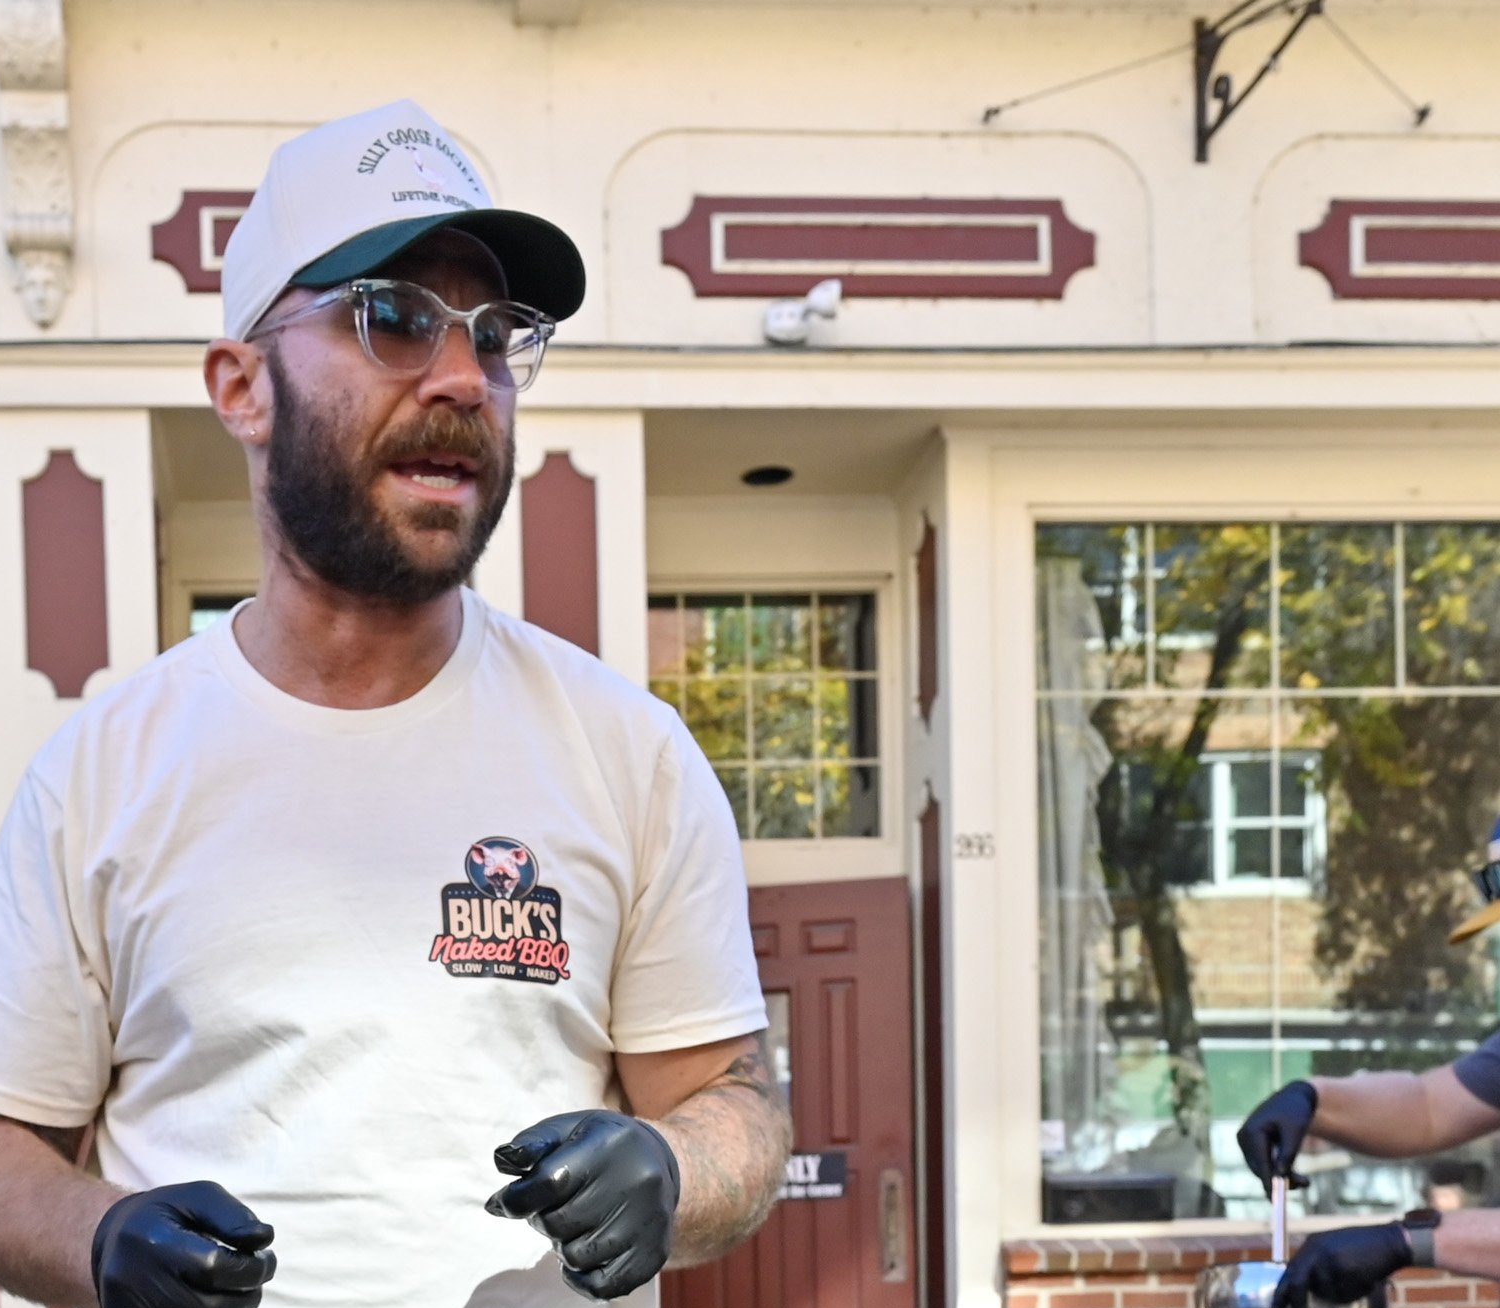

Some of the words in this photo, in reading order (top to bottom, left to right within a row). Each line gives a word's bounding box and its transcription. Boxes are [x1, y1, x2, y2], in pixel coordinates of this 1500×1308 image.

[357, 139, 391, 175] SILLY
[387, 128, 432, 146] GOOSE
[392, 190, 441, 202] LIFETIME
[448, 898, 557, 943] BUCK'S
[430, 935, 517, 965] Naked
[516, 938, 570, 979] BBQ
[451, 963, 483, 974] SLOW
[493, 963, 516, 975] LOW
[526, 967, 557, 981] NAKED
